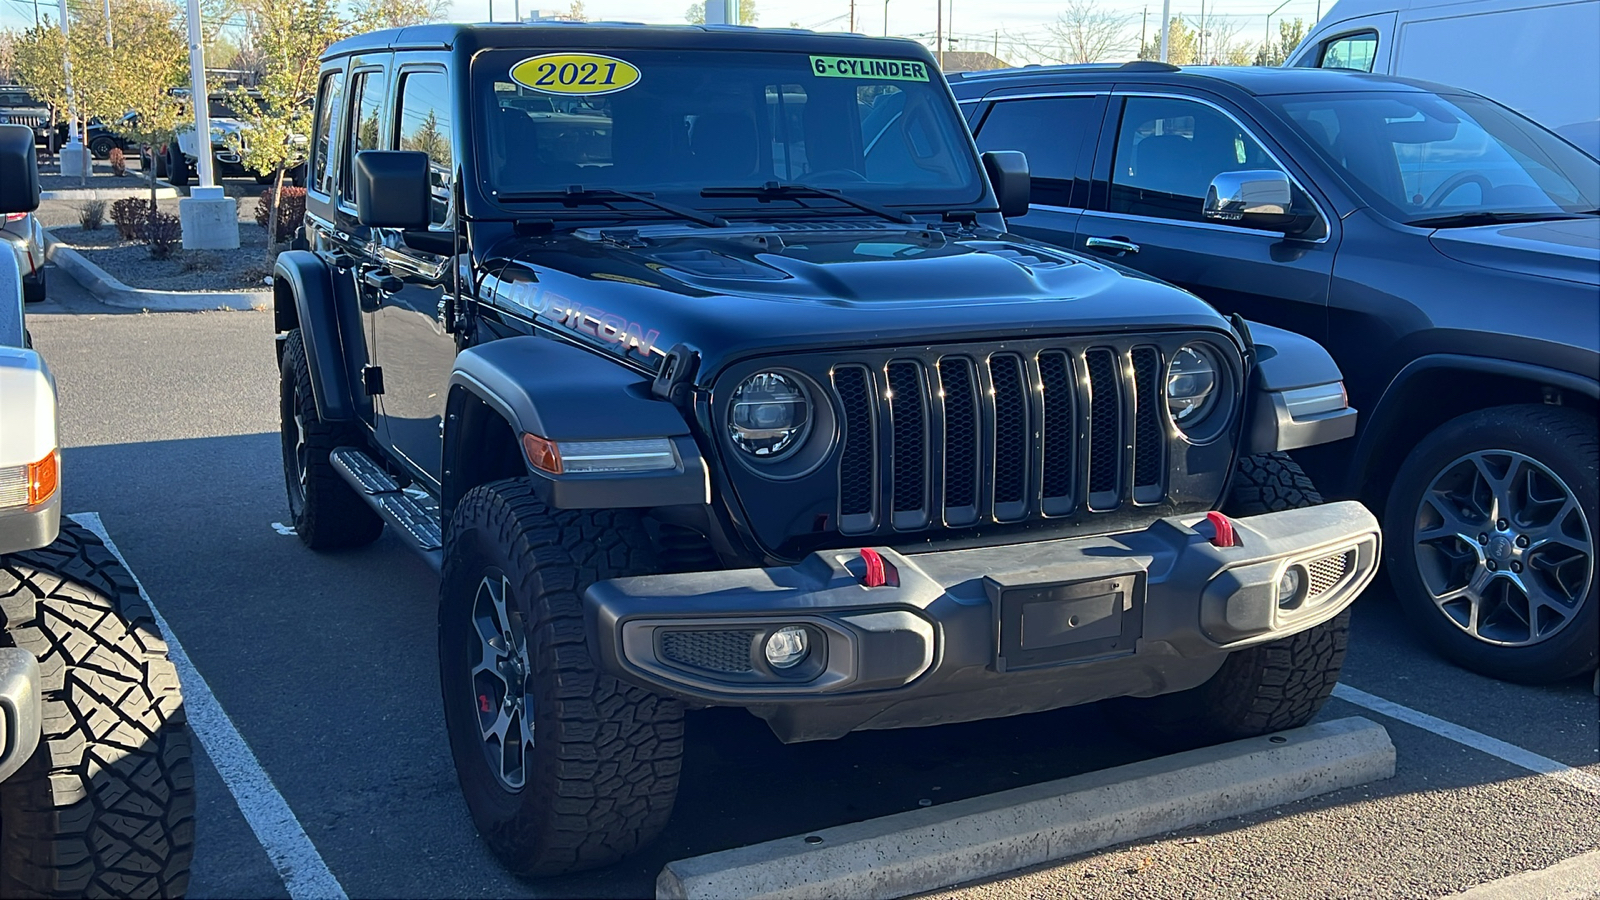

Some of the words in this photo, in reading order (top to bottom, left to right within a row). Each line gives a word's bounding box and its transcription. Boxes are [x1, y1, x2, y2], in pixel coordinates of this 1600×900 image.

[535, 63, 618, 86] 2021
[815, 59, 925, 79] 6-CYLINDER
[508, 279, 660, 358] RUBICON
